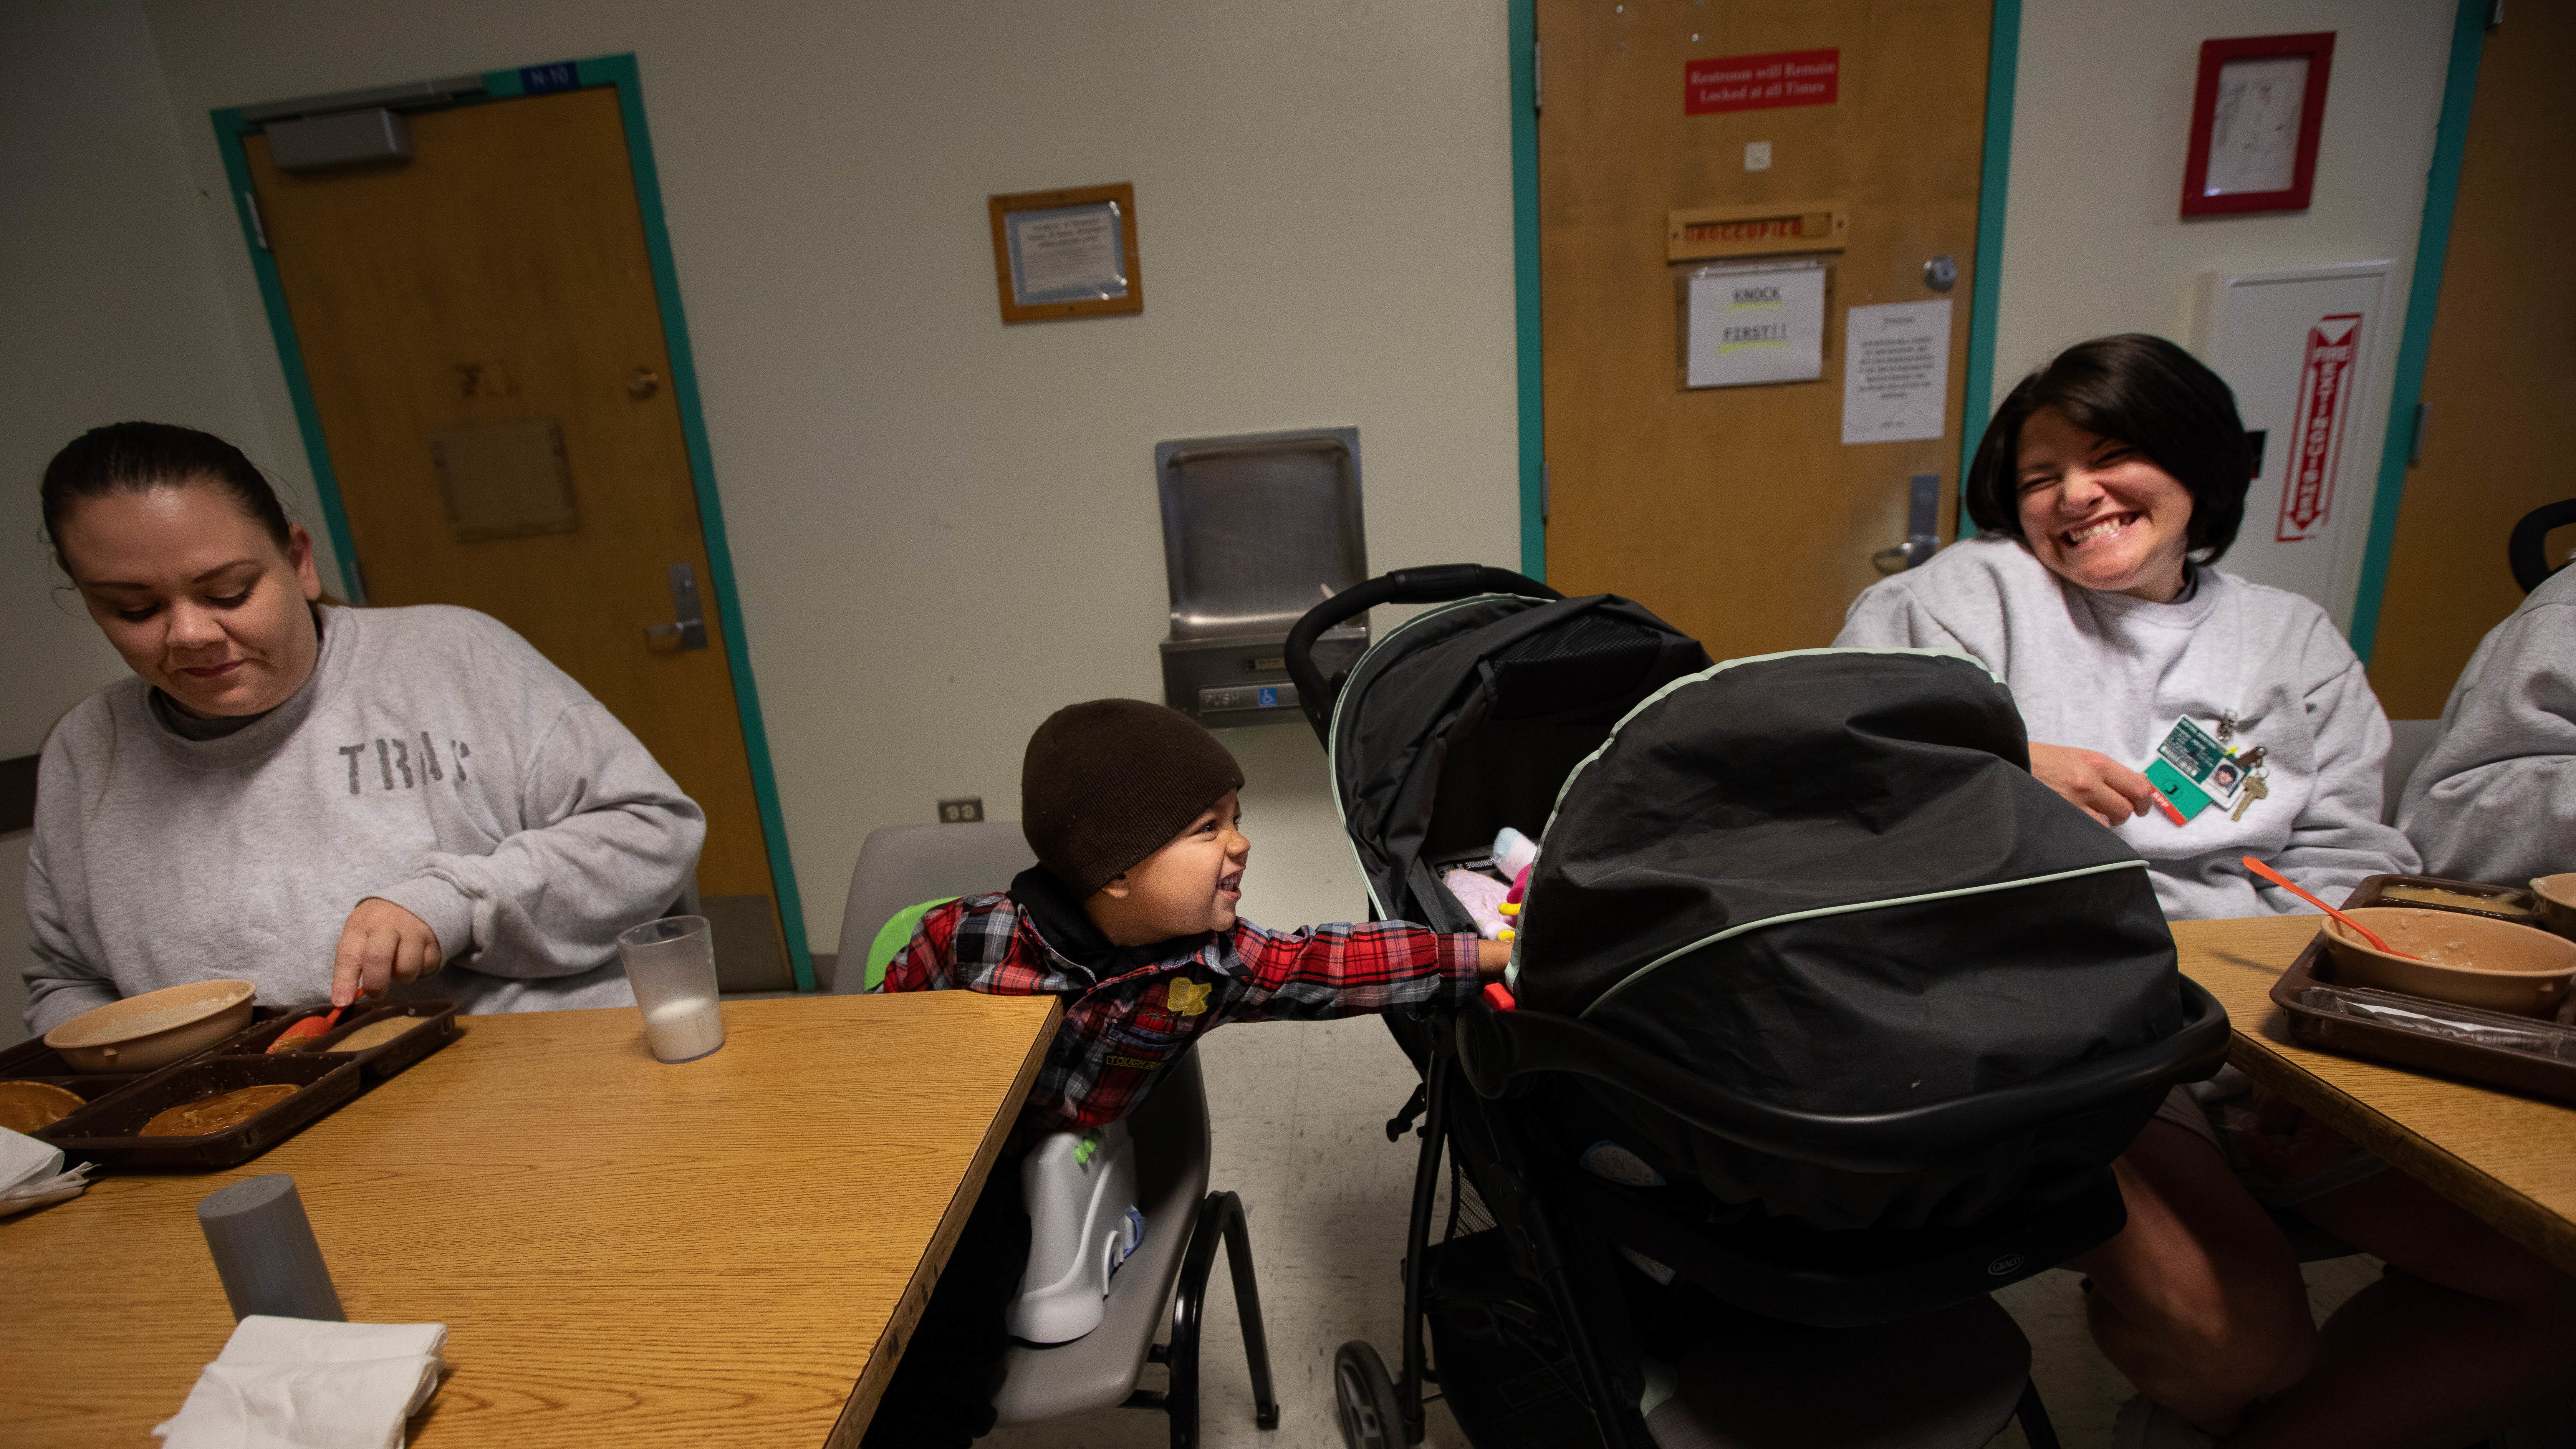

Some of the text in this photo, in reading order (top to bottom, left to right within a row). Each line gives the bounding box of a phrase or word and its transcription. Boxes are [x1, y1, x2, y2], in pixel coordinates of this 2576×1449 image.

[1691, 69, 1752, 84] Restroom
[1785, 61, 1836, 77] Remain
[1700, 81, 1826, 103] Locked at all Times
[1733, 286, 1781, 303] KNOCK
[1723, 324, 1787, 341] FIRST!!
[2313, 345, 2351, 362] FIRE
[2297, 362, 2338, 522] EXTINGUISHER
[1205, 692, 1239, 705] PUSH
[2165, 783, 2179, 795] J
[1465, 859, 1493, 869] SNUGRIDE
[1109, 1055, 1147, 1066] TOUGH
[1992, 1257, 2021, 1272] GRACO
